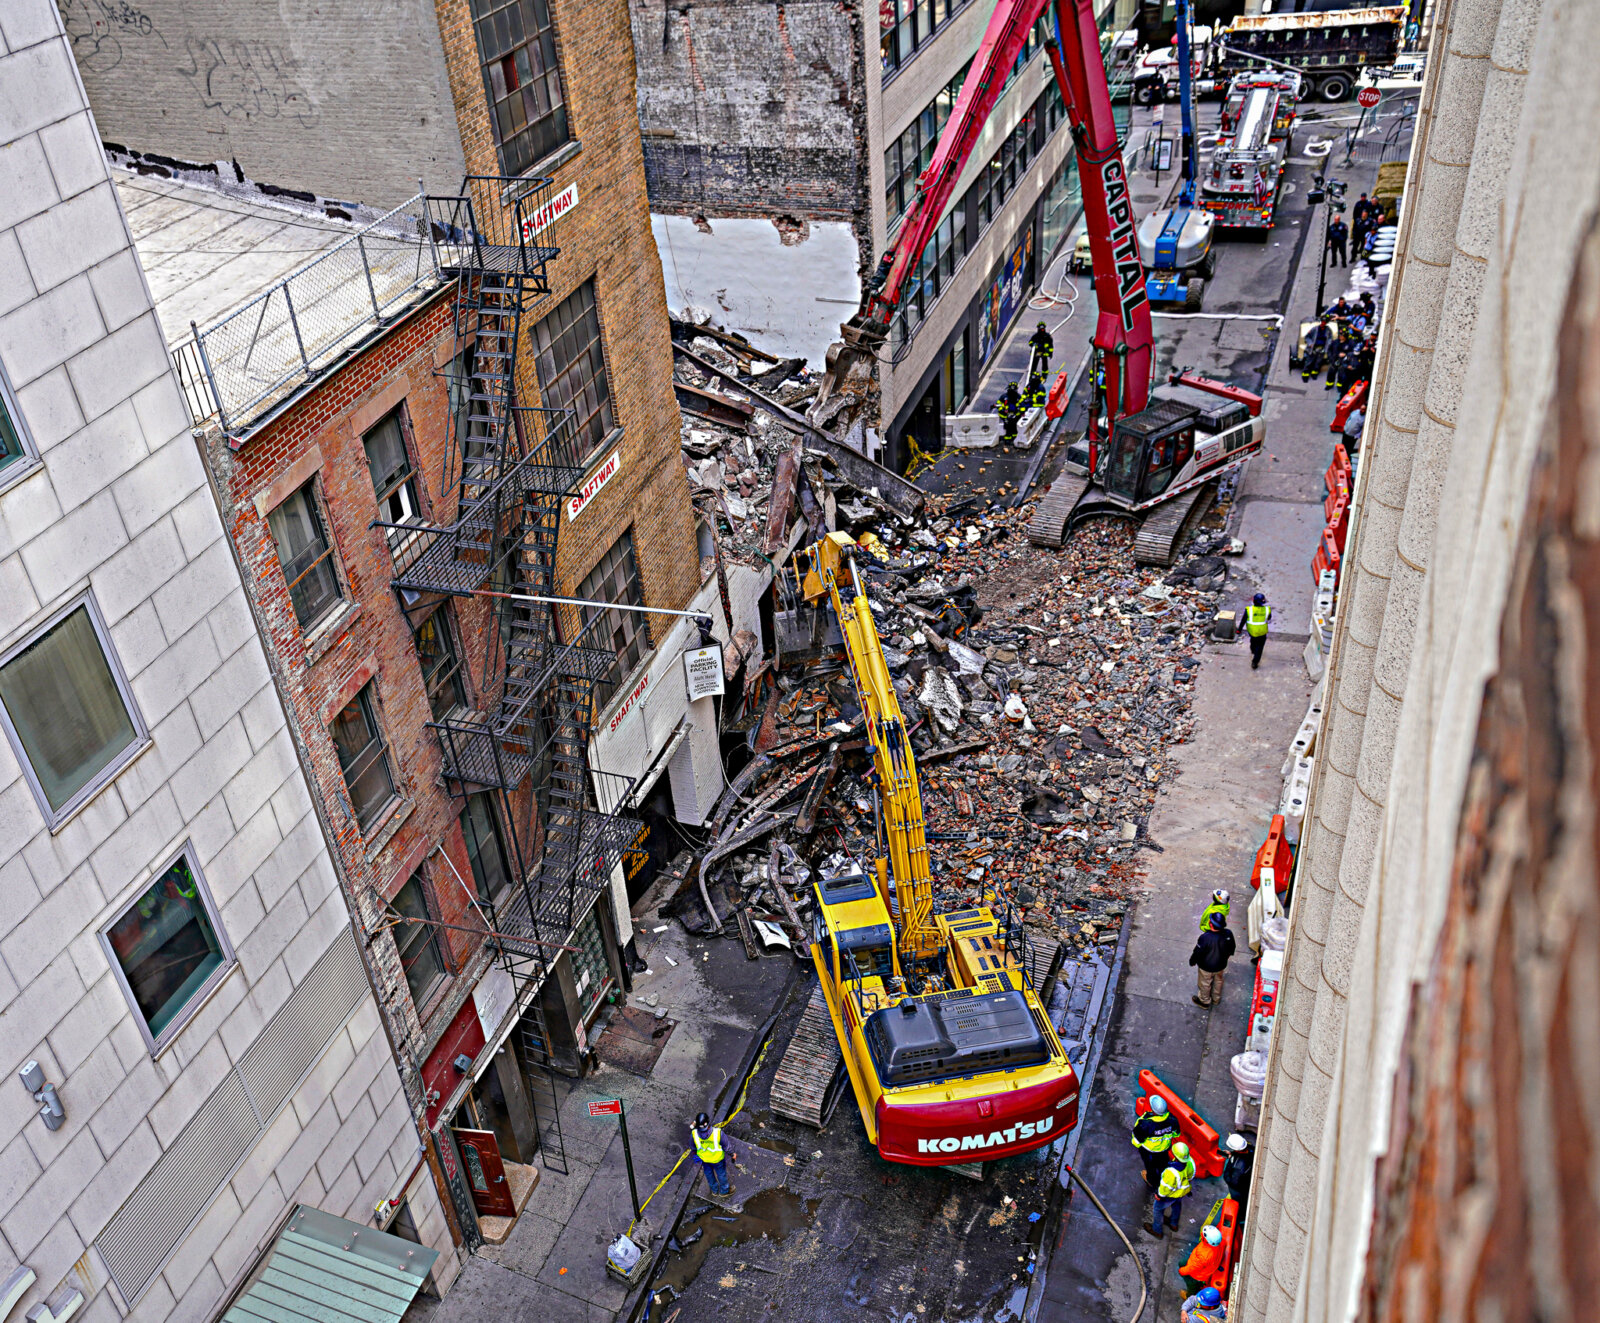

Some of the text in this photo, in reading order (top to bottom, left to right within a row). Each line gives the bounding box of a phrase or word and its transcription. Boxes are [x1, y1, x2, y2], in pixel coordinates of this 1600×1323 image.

[1250, 27, 1369, 44] CAPITAL
[1360, 92, 1380, 102] STOP
[523, 189, 573, 238] SHAFTWAY
[1222, 201, 1249, 210] FDNY
[1101, 158, 1148, 332] CAPITAL
[572, 457, 615, 513] SHAFTWAY
[690, 660, 717, 668] PARKING
[690, 665, 718, 673] FACILITY
[611, 673, 649, 732] SHAFTWAY
[628, 852, 650, 880] HOURS
[918, 1116, 1054, 1153] KOMATSU
